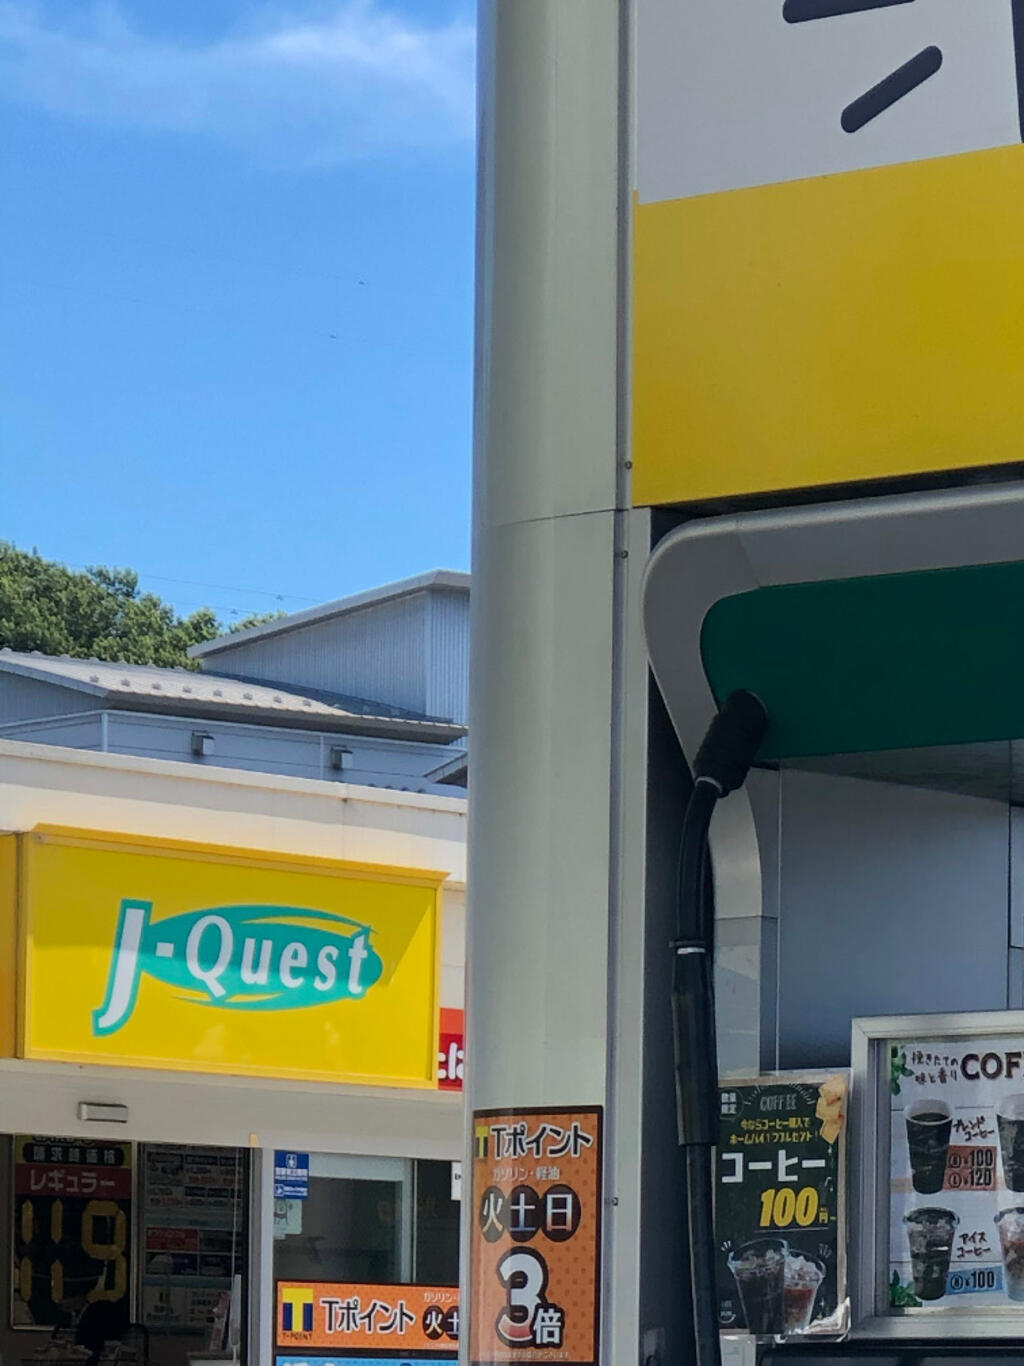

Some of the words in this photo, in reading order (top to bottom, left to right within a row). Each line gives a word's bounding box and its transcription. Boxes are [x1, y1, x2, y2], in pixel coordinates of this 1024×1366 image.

[94, 900, 374, 1034] J-Quest
[30, 1169, 115, 1194] レギュラー
[721, 1150, 825, 1183] コーヒー
